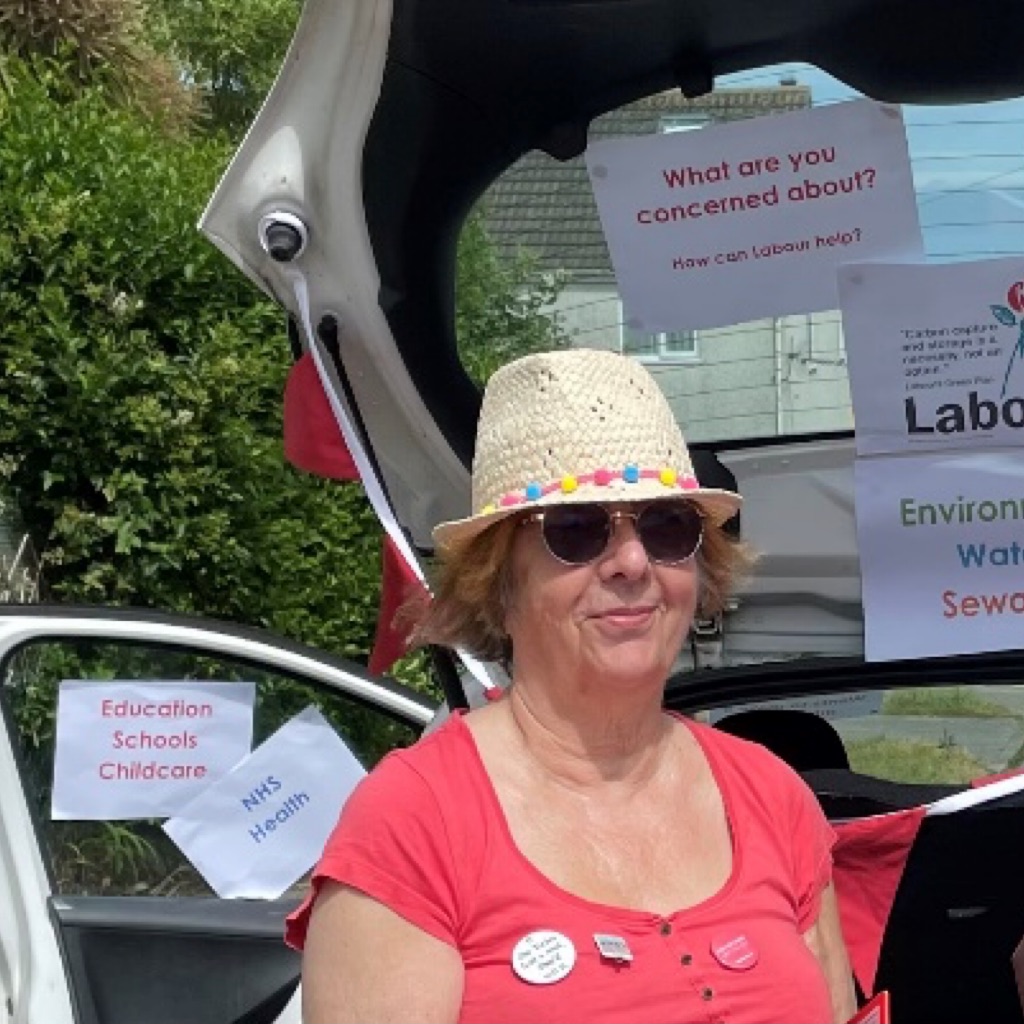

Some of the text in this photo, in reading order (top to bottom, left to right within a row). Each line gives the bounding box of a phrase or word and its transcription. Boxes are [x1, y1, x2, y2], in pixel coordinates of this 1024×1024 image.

[663, 146, 836, 189] What are you
[636, 168, 877, 224] concerned about?
[672, 254, 709, 270] How
[714, 249, 748, 265] can
[815, 228, 862, 248] help?
[101, 699, 213, 719] Education
[112, 730, 198, 749] Schools
[99, 762, 207, 780] Childcare
[240, 775, 283, 812] NHS
[248, 790, 310, 843] Health
